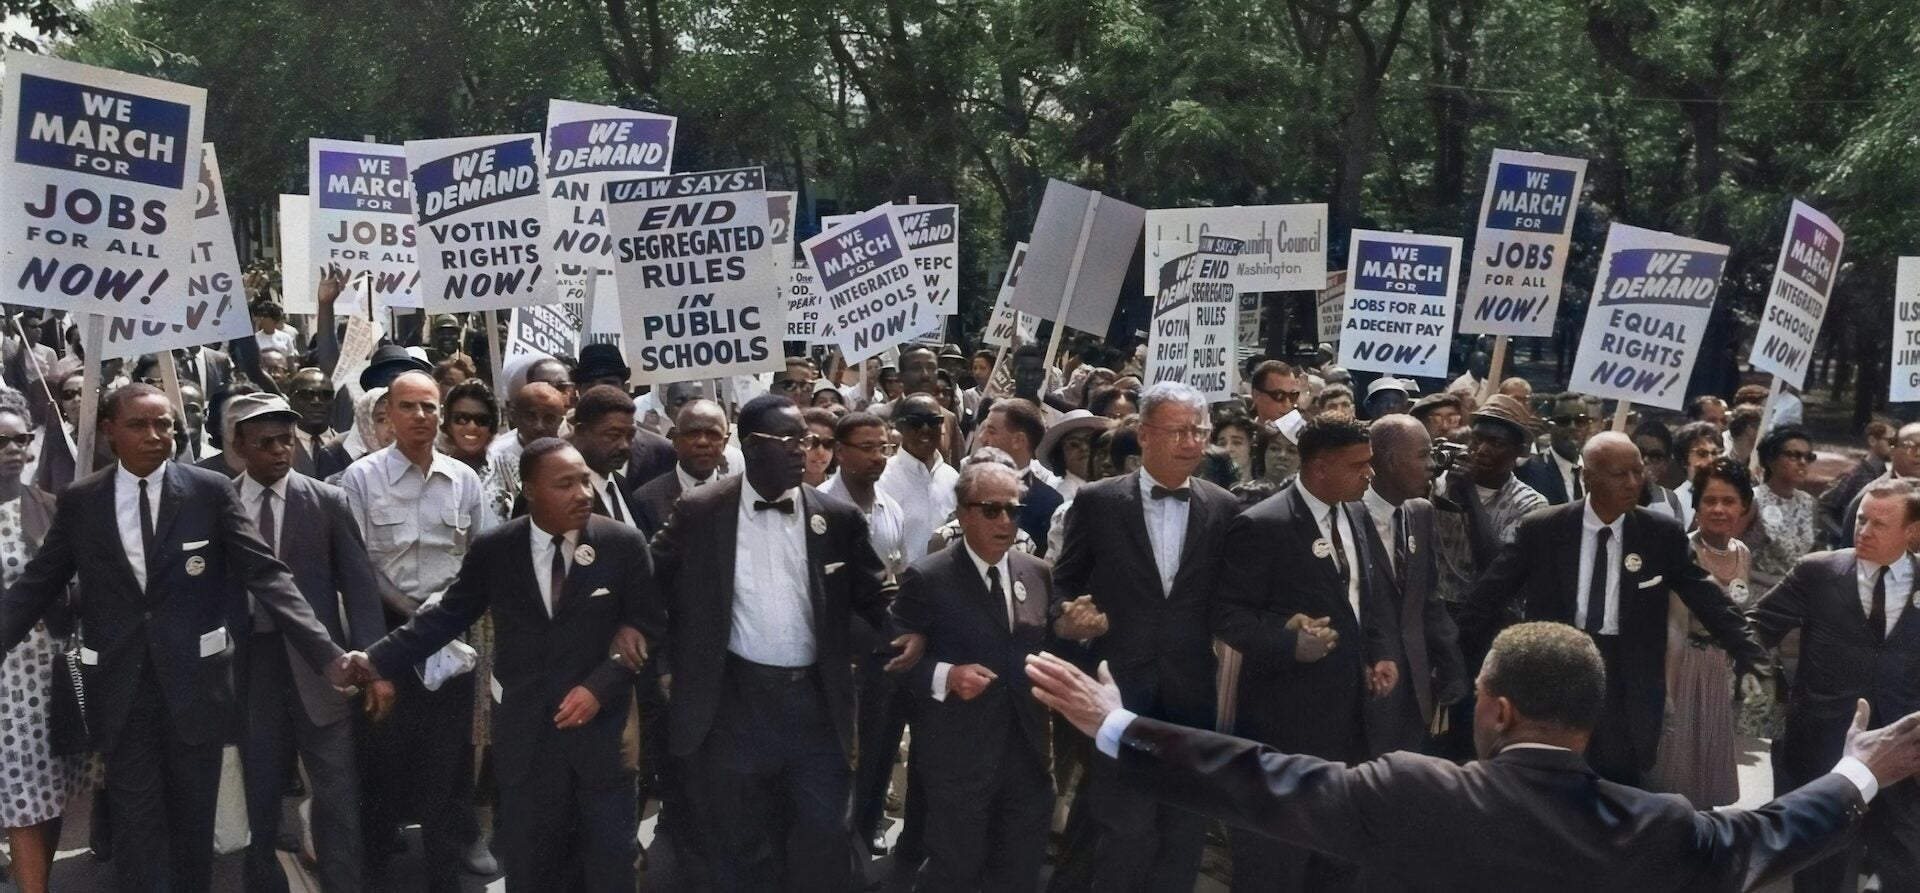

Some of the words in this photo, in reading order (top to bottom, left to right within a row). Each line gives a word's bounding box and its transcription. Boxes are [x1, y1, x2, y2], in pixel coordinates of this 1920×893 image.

[82, 91, 131, 122] WE
[30, 112, 174, 163] MARCH
[588, 121, 633, 144] WE
[75, 154, 130, 175] FOR
[358, 158, 390, 175] WE
[453, 148, 496, 178] WE
[555, 142, 663, 171] DEMAND
[424, 164, 534, 217] DEMAND
[552, 180, 589, 201] AN
[615, 180, 671, 200] UAW
[678, 171, 759, 194] SAYS:
[1526, 170, 1549, 190] WE
[24, 184, 167, 235] JOBS
[356, 199, 392, 210] FOR
[638, 200, 736, 231] END
[1496, 190, 1566, 218] MARCH
[328, 220, 416, 247] JOBS
[429, 218, 541, 244] VOTING
[902, 212, 930, 232] WE
[1516, 217, 1541, 230] FOR
[27, 227, 89, 249] FOR
[106, 239, 159, 258] ALL
[619, 226, 764, 263] SEGREGATED
[837, 231, 863, 249] WE
[1277, 219, 1321, 253] Council
[1813, 229, 1828, 250] WE
[330, 249, 369, 260] FOR
[382, 252, 415, 263] ALL
[441, 244, 539, 269] RIGHTS
[824, 234, 891, 277] MARCH
[914, 256, 952, 270] FEPC
[1391, 246, 1418, 260] WE
[1486, 242, 1554, 271] JOBS
[1647, 252, 1691, 275] WE
[1791, 239, 1832, 280] MARCH
[17, 256, 169, 305] NOW!
[642, 256, 745, 289] RULES
[849, 261, 876, 277] FOR
[1176, 256, 1195, 280] WE
[1199, 259, 1229, 279] END
[1362, 260, 1442, 282] MARCH
[1801, 268, 1817, 286] FOR
[443, 264, 542, 300] NOW!
[566, 288, 586, 299] FO
[830, 264, 909, 310] INTEGRATED
[1191, 283, 1234, 303] SEGREGATED
[1386, 281, 1417, 292] FOR
[1485, 274, 1514, 286] FOR
[1521, 275, 1547, 288] ALL
[1608, 276, 1715, 301] DEMAND
[677, 293, 715, 309] IN
[838, 284, 916, 329] SCHOOLS
[1350, 298, 1385, 312] JOBS
[1389, 300, 1415, 314] FOR
[1421, 304, 1446, 317] ALL
[1474, 294, 1549, 322] NOW!
[1775, 278, 1823, 320] INTEGRATED
[643, 307, 761, 340] PUBLIC
[854, 302, 918, 352] NOW!
[1197, 307, 1225, 326] RULES
[1346, 318, 1358, 329] A
[1360, 319, 1413, 334] DECENT
[1417, 323, 1445, 337] PAY
[1609, 309, 1686, 344] EQUAL
[1768, 305, 1814, 345] SCHOOLS
[1204, 334, 1216, 345] IN
[1600, 334, 1684, 368] RIGHTS
[641, 336, 769, 372] SCHOOLS
[1193, 347, 1225, 368] PUBLIC
[1353, 341, 1437, 365] NOW!
[1763, 335, 1806, 373] NOW!
[1191, 372, 1225, 392] SCHOOLS
[1590, 360, 1680, 397] NOW!
